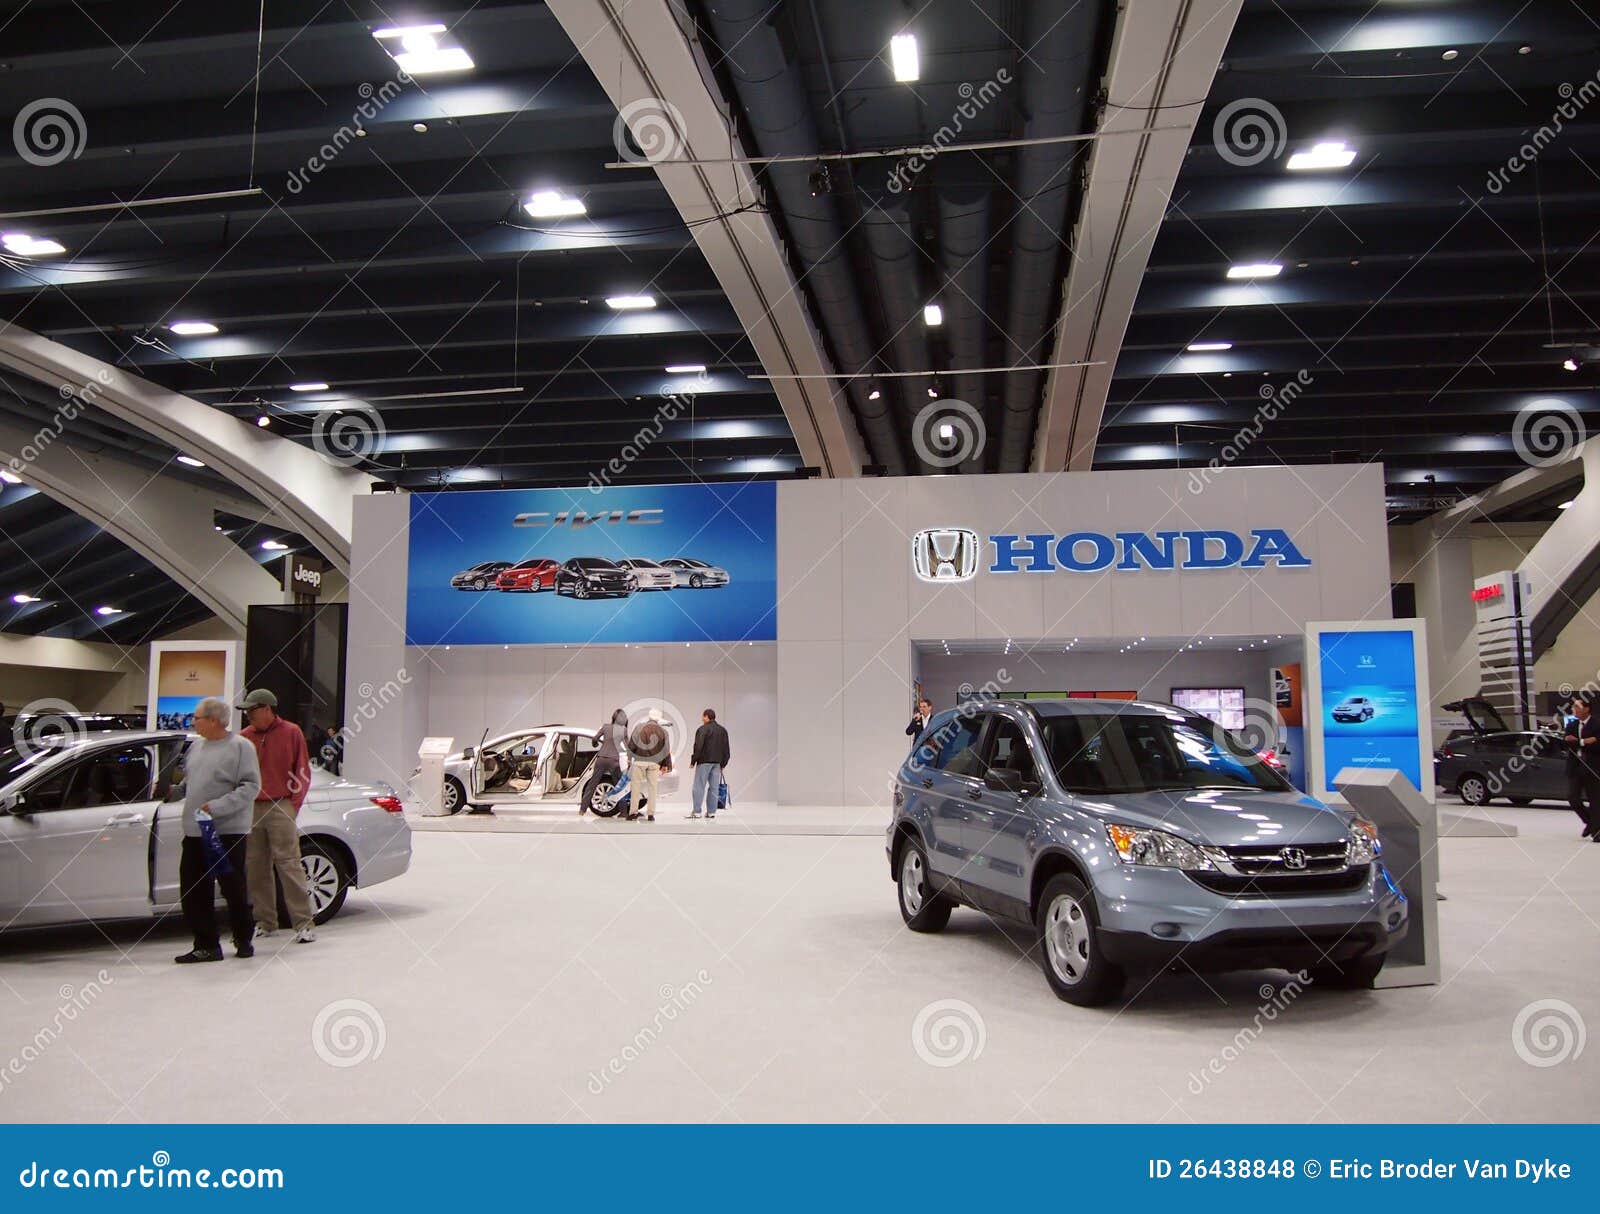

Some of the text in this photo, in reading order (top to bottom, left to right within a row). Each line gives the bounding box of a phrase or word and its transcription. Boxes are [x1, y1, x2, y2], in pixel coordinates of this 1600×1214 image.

[512, 508, 664, 530] CIVIC
[989, 529, 1312, 573] HONDA
[294, 564, 321, 587] Jeep
